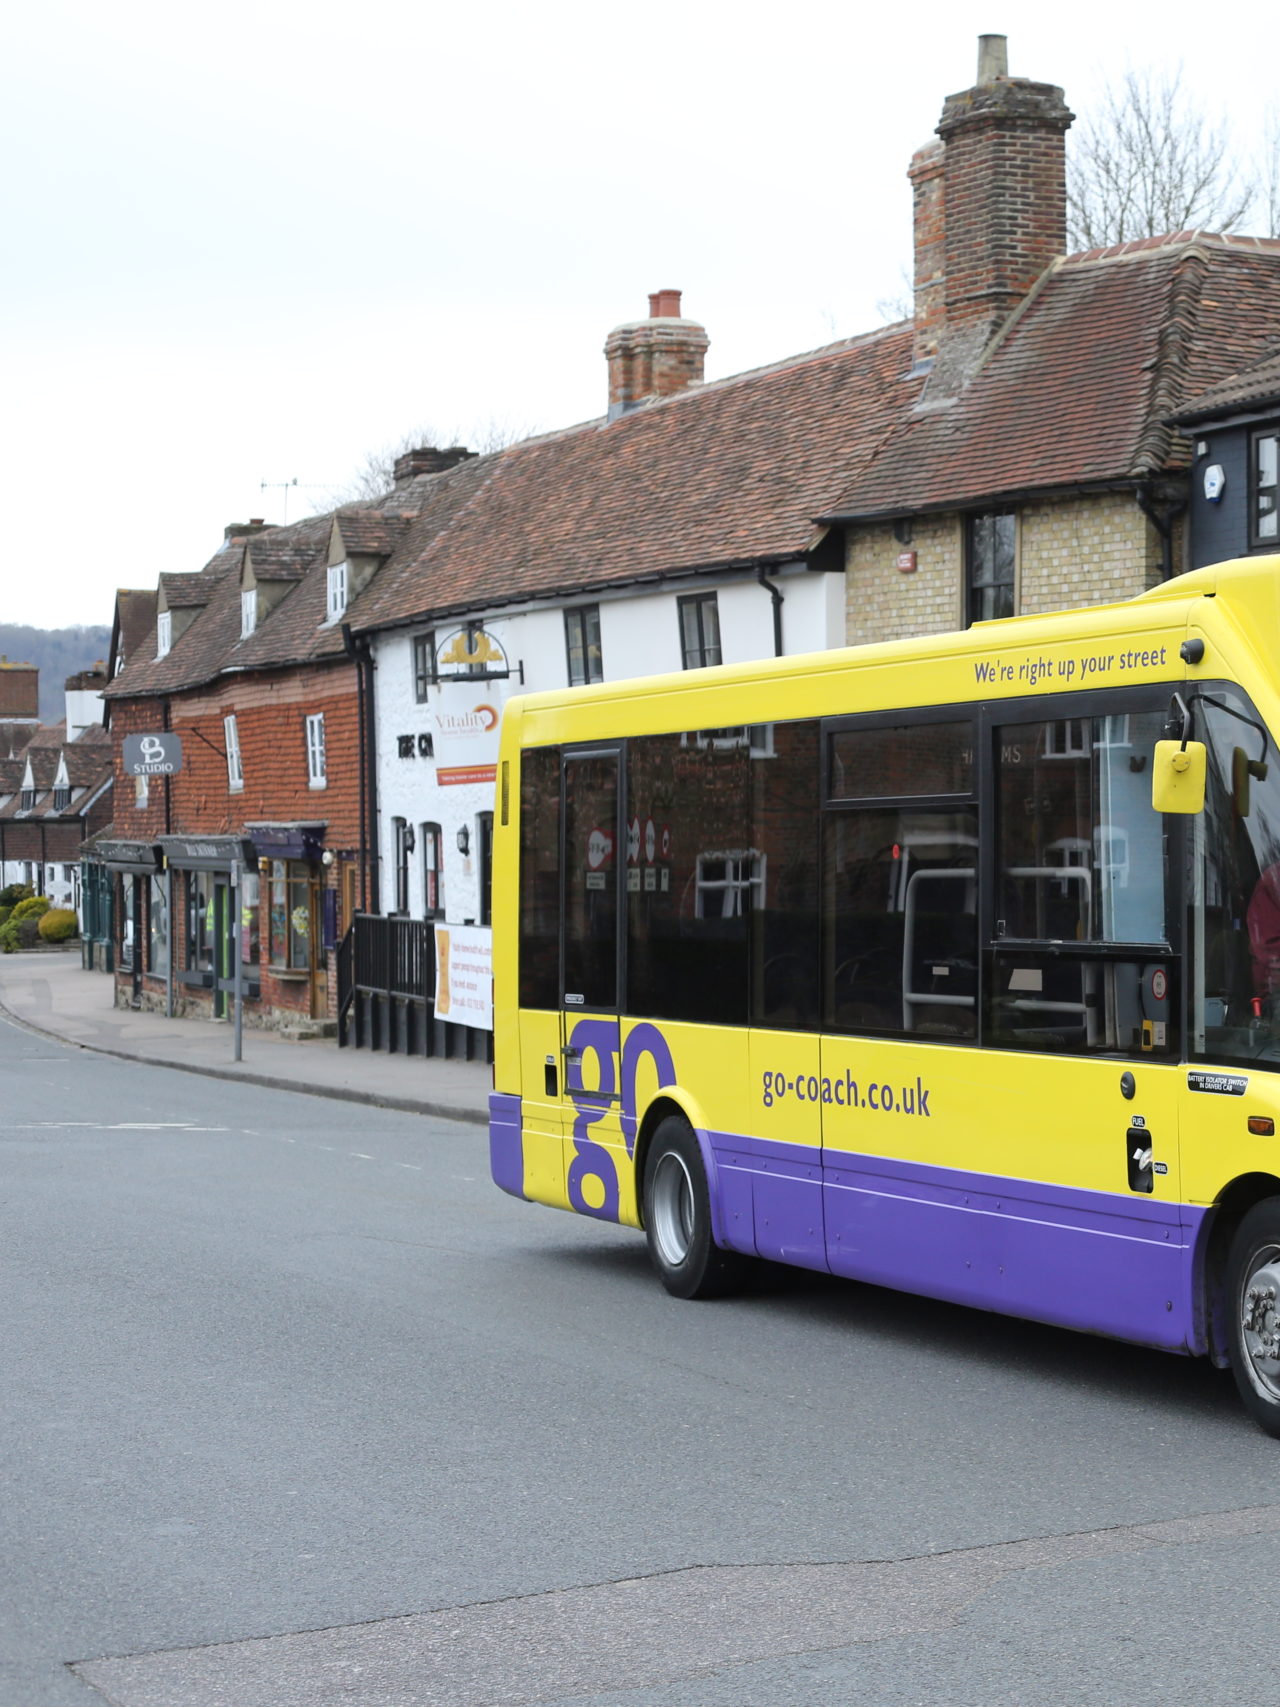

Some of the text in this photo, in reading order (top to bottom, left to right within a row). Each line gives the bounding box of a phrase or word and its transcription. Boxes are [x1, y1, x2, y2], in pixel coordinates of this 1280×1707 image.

[974, 645, 1166, 686] We're right up your street
[435, 711, 488, 729] Vitality
[133, 762, 174, 774] STUDIO
[1222, 1084, 1233, 1092] CAB
[1228, 1078, 1248, 1087] SWITCH
[762, 1069, 931, 1118] go-coach.co.uk
[1132, 1117, 1145, 1127] FUEL
